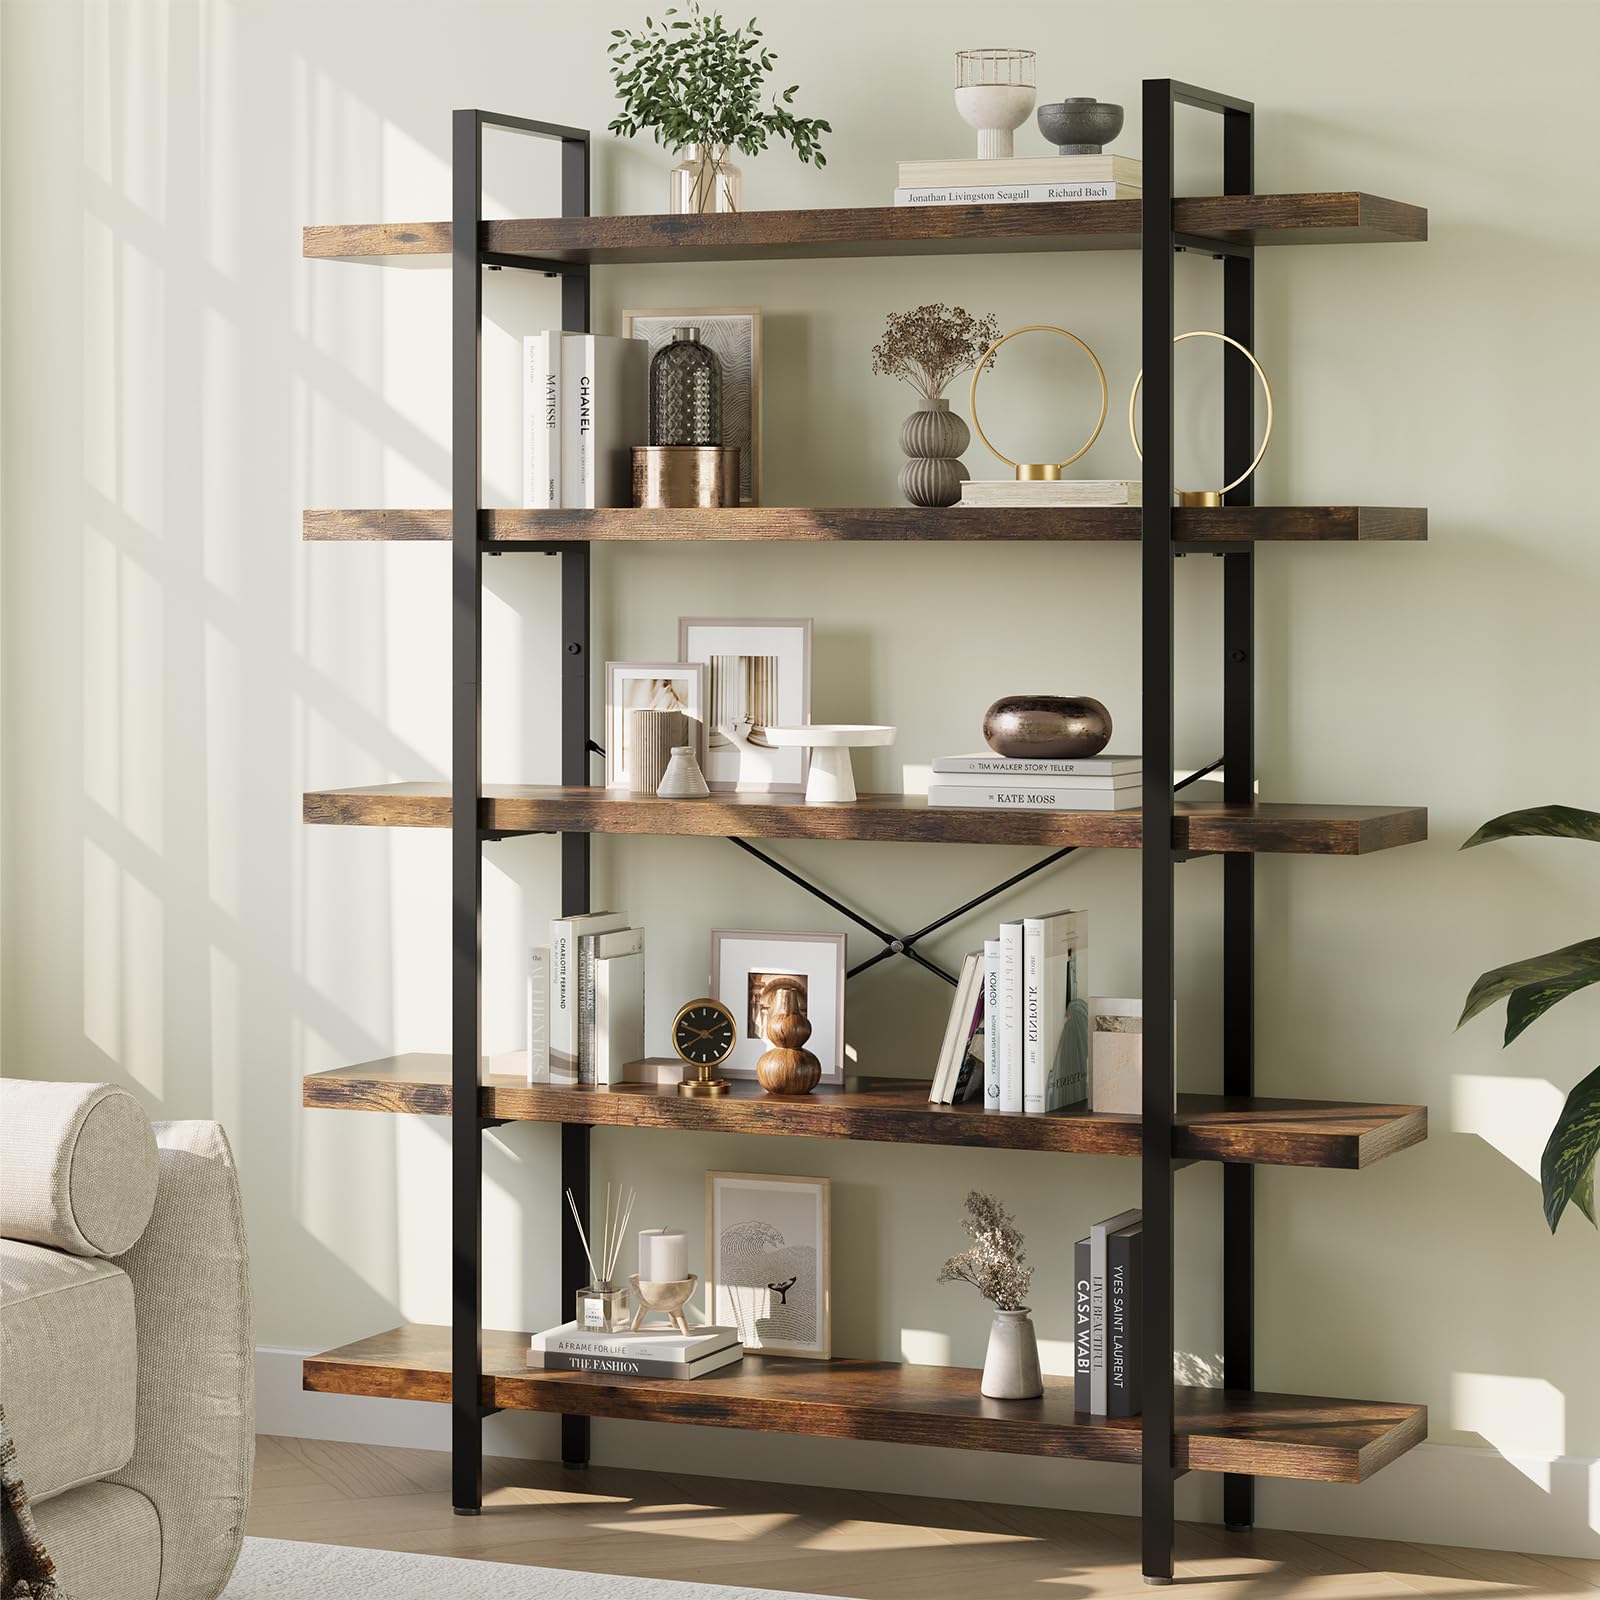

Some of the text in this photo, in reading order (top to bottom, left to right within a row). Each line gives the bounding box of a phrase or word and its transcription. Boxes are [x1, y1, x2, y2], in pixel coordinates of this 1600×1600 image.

[908, 190, 1030, 203] Jonathan Livingston Seagull
[1048, 186, 1108, 198] Richard Bach
[546, 374, 556, 429] MATISSE
[580, 376, 590, 435] CHANEL
[992, 763, 1023, 771] WALKER
[1024, 763, 1048, 772] STORY
[1050, 764, 1075, 772] TELLER
[997, 794, 1056, 804] KATE MOSS
[1077, 1280, 1090, 1374] CASA WABI
[1093, 1276, 1103, 1371] LIVE BEAUTIFUL
[1113, 1265, 1124, 1389] YVES SAINT LAURENT
[558, 1341, 565, 1349] A
[565, 1342, 592, 1351] FRAME
[594, 1344, 609, 1353] FOR
[609, 1346, 627, 1354] LIFE
[568, 1357, 640, 1373] THE FASHION
